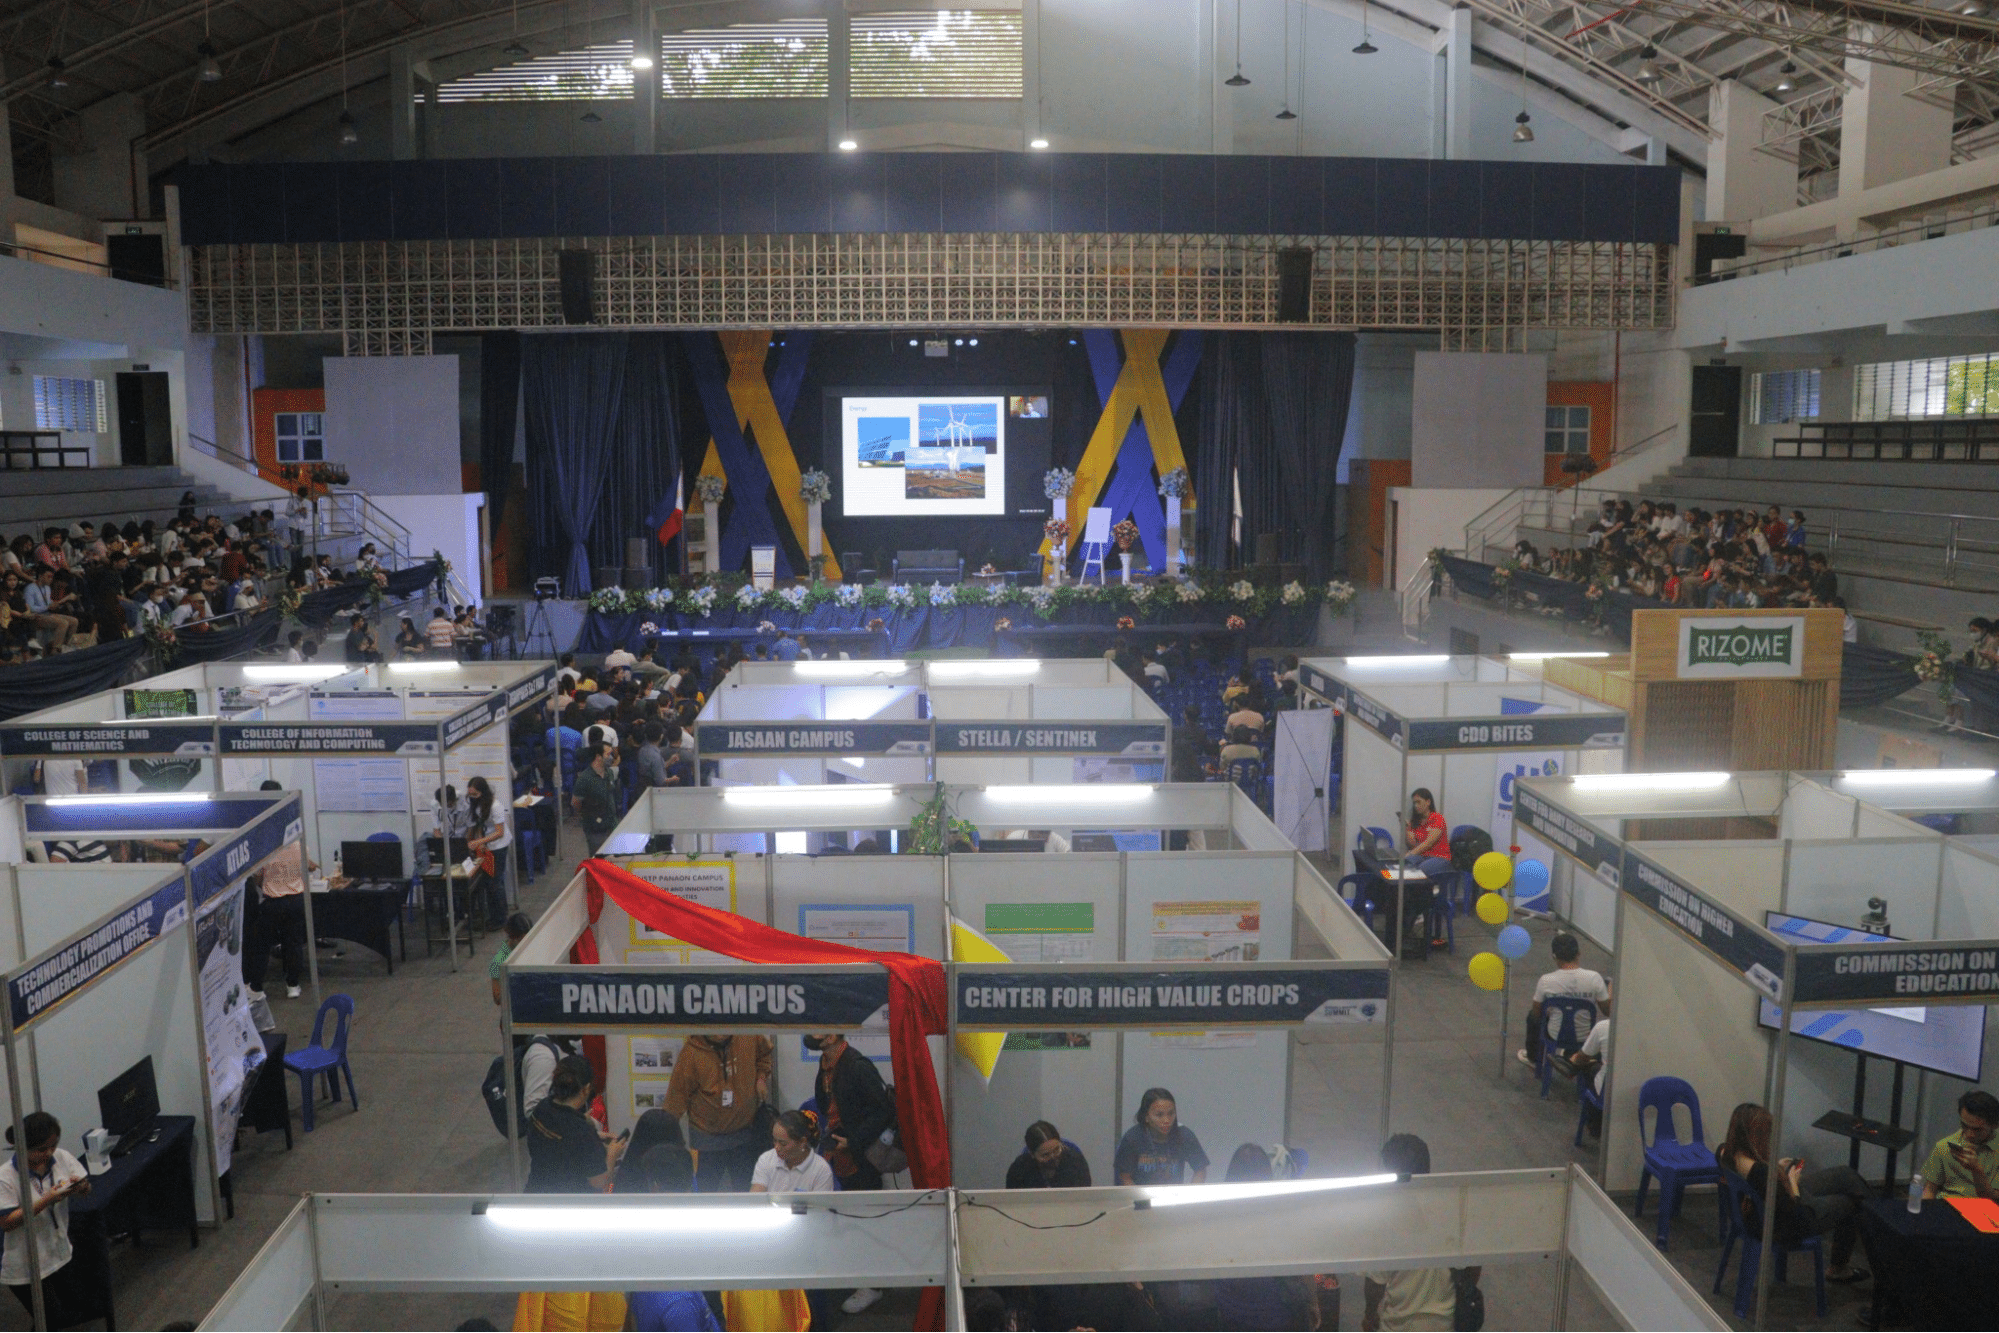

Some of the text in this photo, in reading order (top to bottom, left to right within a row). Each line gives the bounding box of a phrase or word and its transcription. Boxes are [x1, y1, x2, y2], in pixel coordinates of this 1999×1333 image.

[1697, 634, 1784, 657] RIZOME
[24, 729, 150, 742] COLLEGE OF SCIENCE AND
[231, 739, 386, 750] TECHNOLOGY AND COMPUTING
[241, 728, 373, 739] COLLEGE OF INFORMATION
[727, 730, 855, 748] JASAAN CAMPUS
[958, 729, 1097, 747] STELLA / SENTINEX
[1458, 724, 1534, 744] CDO BITES
[51, 740, 124, 751] MATHEMATICS
[226, 840, 250, 876] ATLAS
[1638, 863, 1734, 938] COMMISSION ON HIGHER
[1659, 894, 1703, 938] EDUCATION
[17, 900, 154, 998] TECHNOLOGY PROMOTIONS AND
[27, 921, 151, 1015] COMMERCIALIZATION OFFICE
[1834, 951, 1997, 975] COMMISSION ON
[561, 983, 807, 1015] PANAON CAMPUS
[964, 984, 1300, 1009] CENTER FOR HIGH VALUE CROPS
